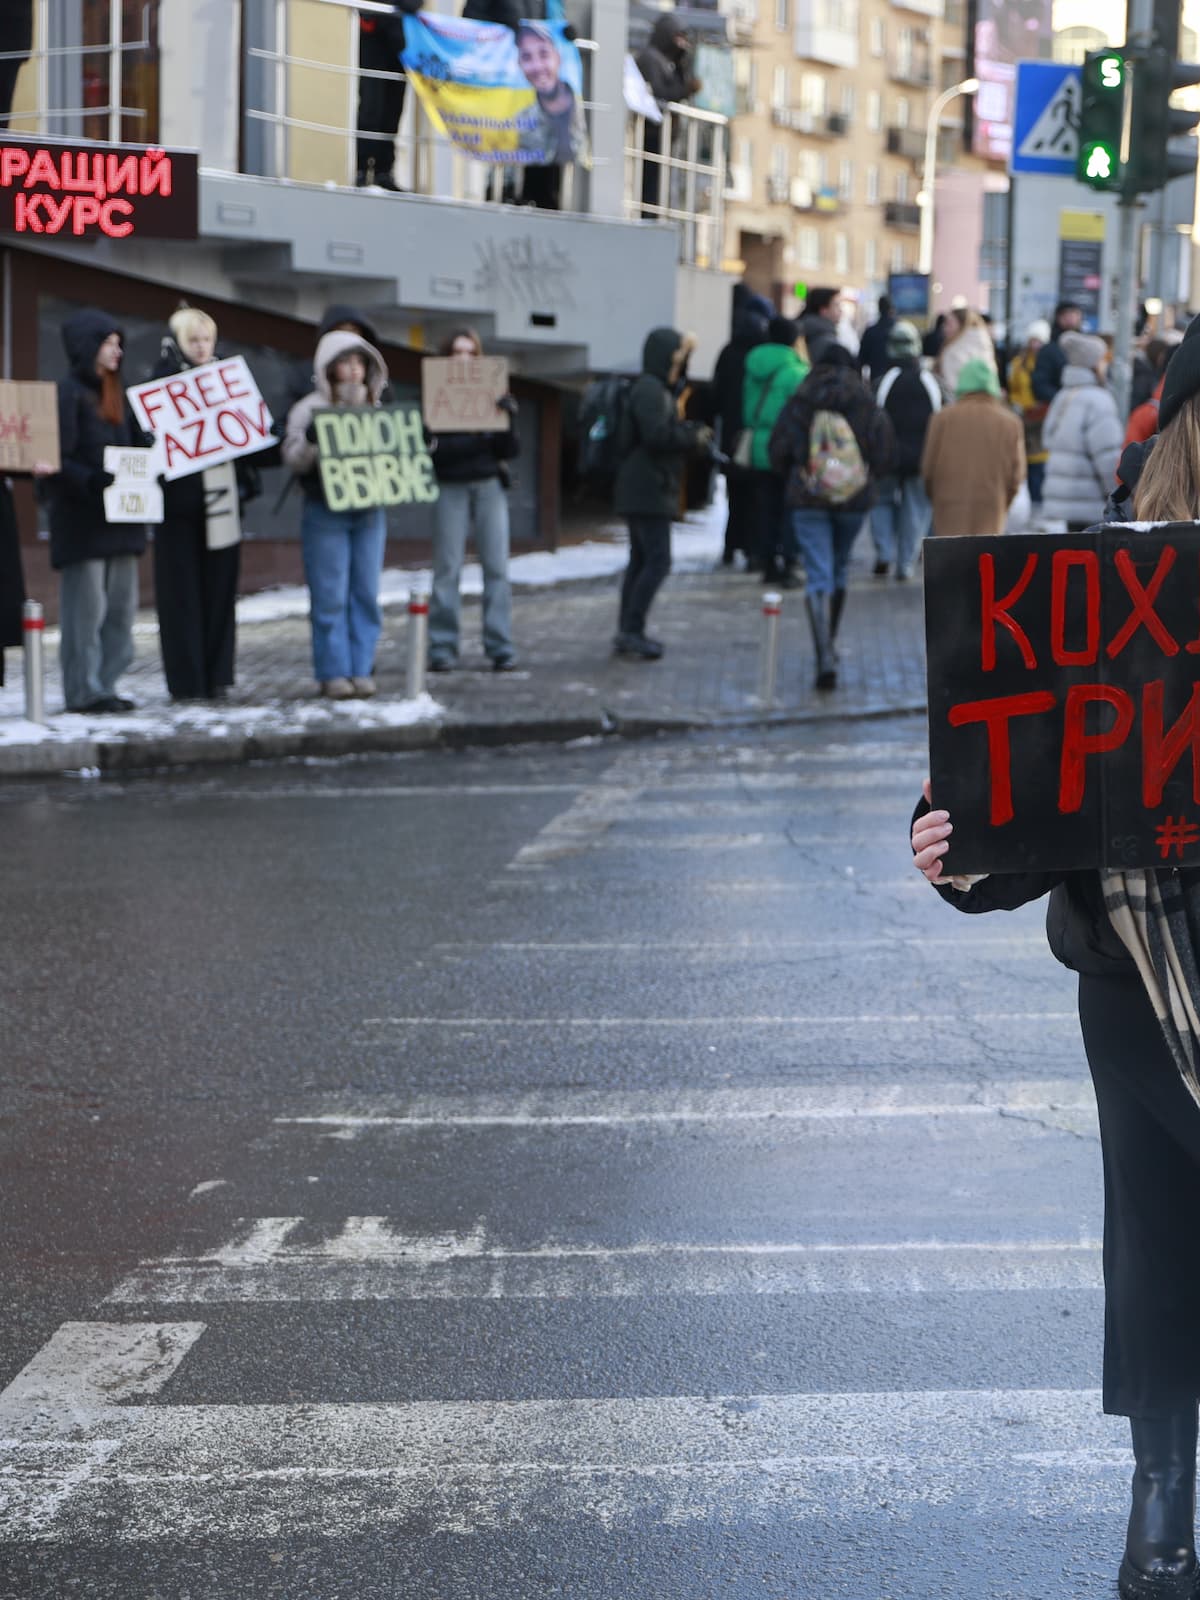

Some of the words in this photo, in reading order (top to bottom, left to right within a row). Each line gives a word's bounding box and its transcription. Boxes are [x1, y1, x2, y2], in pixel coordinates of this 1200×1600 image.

[15, 192, 135, 238] КУРС
[139, 364, 250, 430] FREE
[165, 400, 266, 467] AZOV
[315, 409, 427, 457] ПОЛОН
